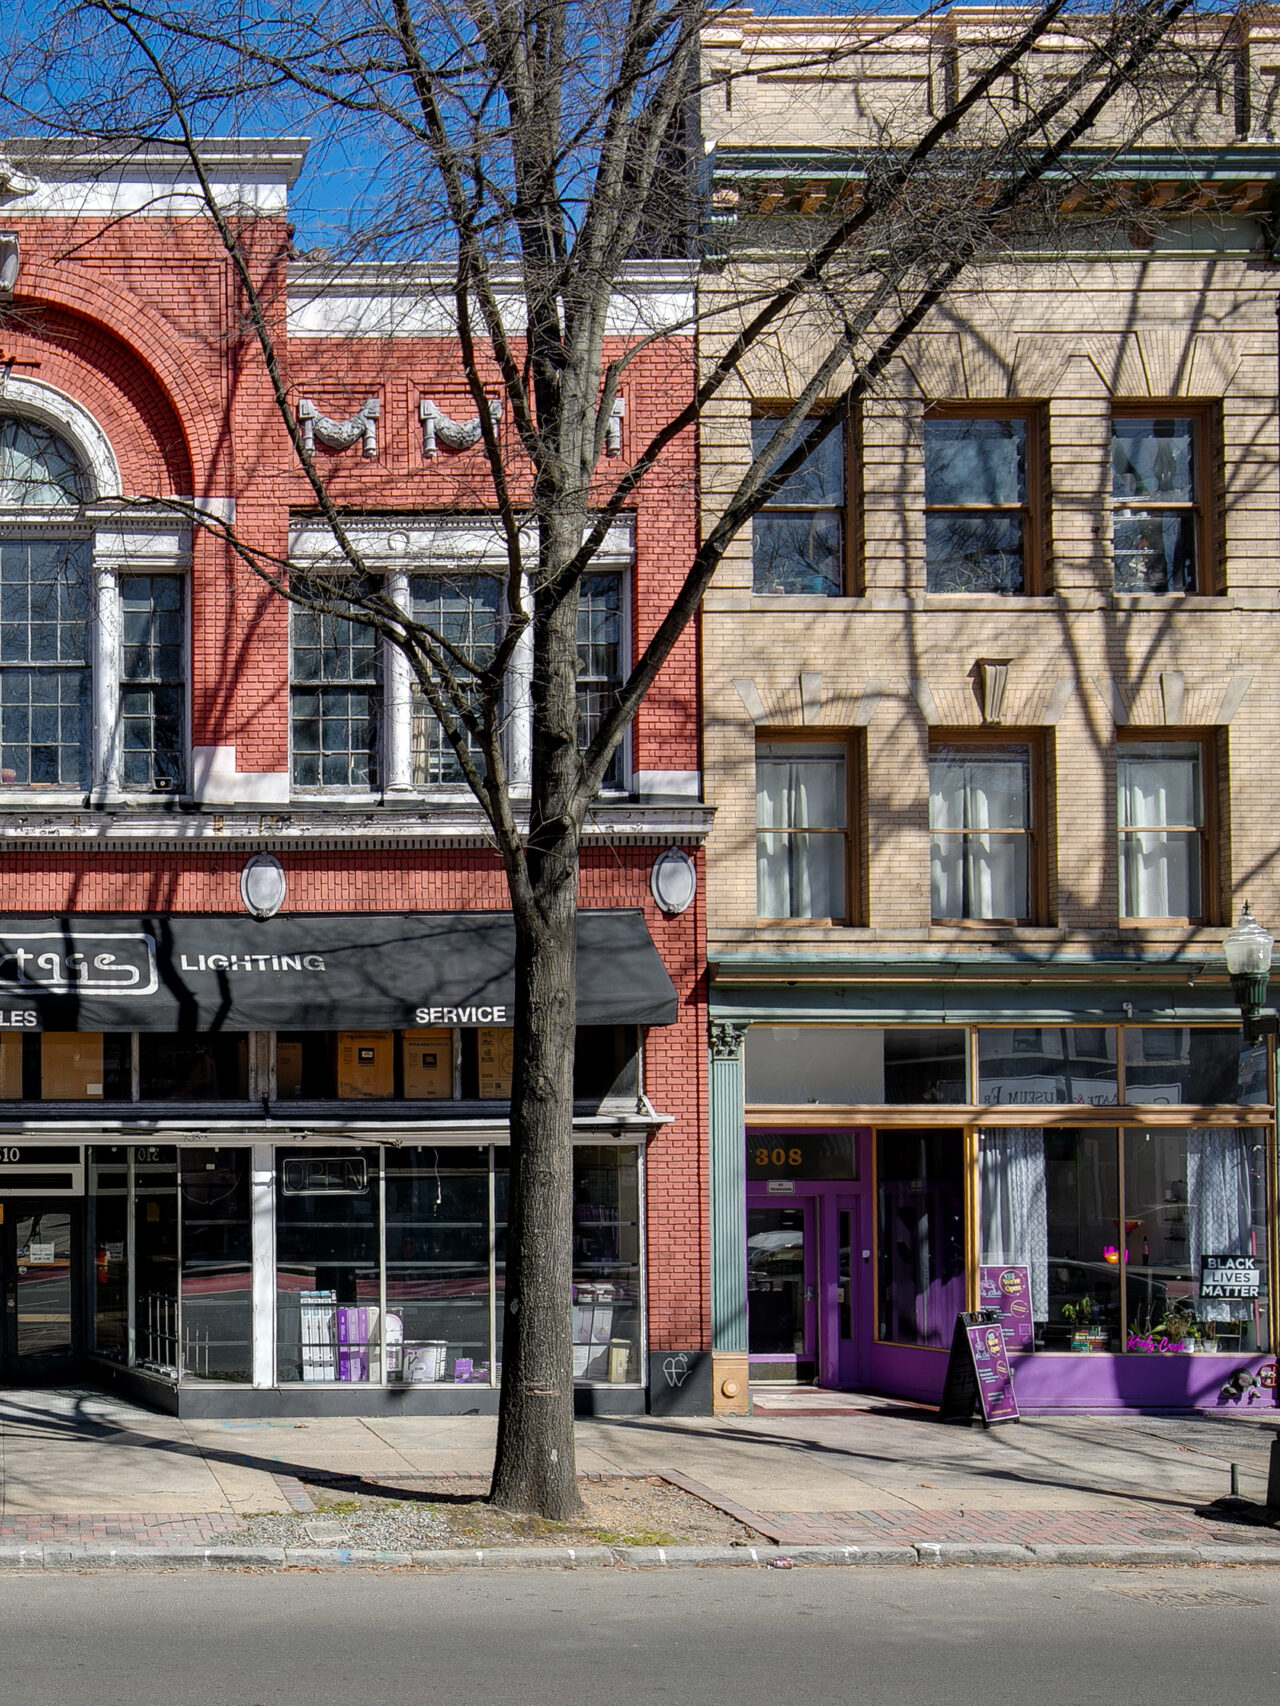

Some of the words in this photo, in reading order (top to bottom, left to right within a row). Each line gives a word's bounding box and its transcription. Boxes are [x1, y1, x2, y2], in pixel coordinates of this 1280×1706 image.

[180, 953, 326, 972] LIGHTING
[415, 1005, 507, 1024] SERVICE
[755, 1148, 803, 1166] 308
[286, 1161, 363, 1190] OPEN
[1207, 1257, 1255, 1270] BLACK
[1212, 1272, 1251, 1283] LIVES
[1201, 1285, 1259, 1297] MATTER
